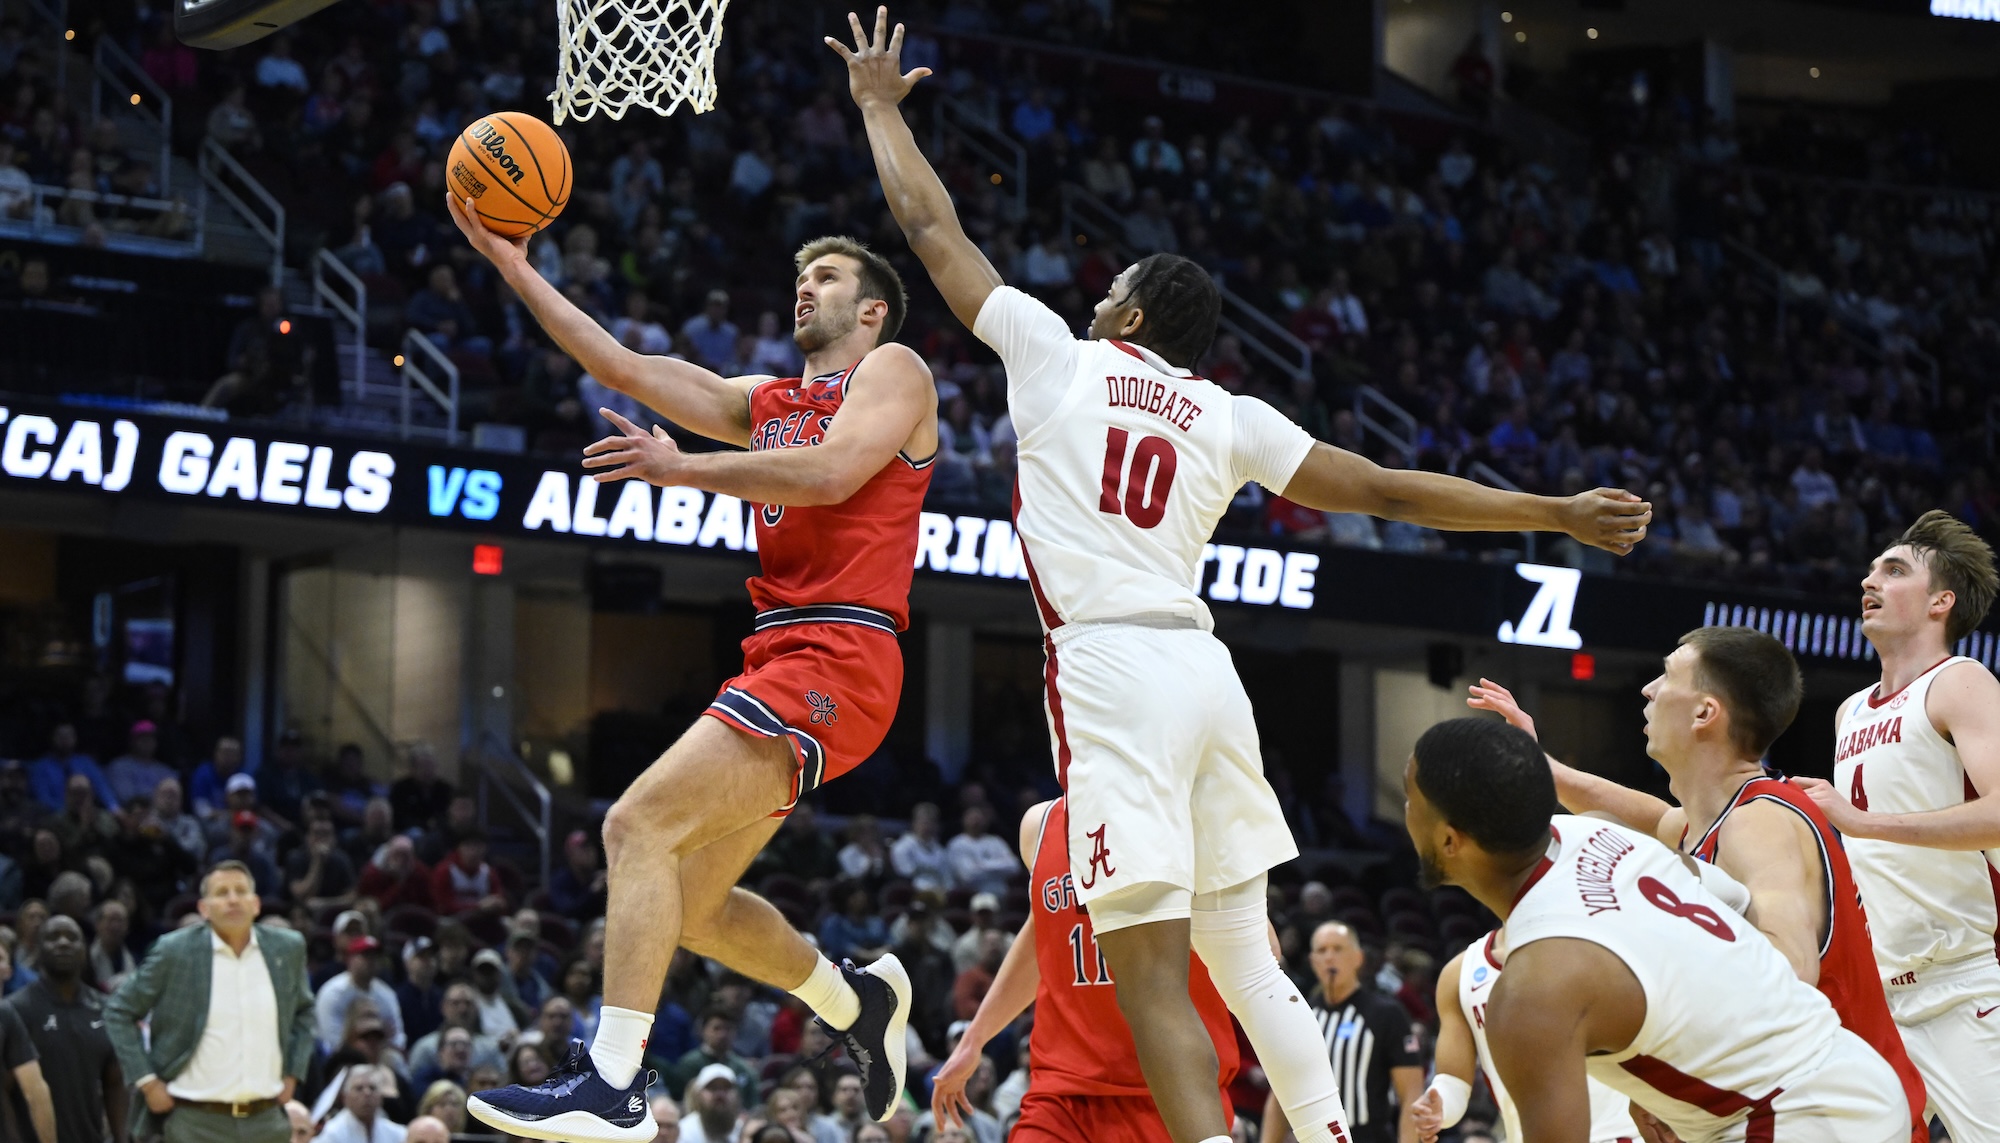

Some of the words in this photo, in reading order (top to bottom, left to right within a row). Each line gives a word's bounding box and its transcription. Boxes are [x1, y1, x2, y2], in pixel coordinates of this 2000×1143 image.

[458, 166, 477, 185] MARCH
[469, 120, 525, 185] Wilson
[457, 173, 481, 198] MADNESS
[1106, 376, 1203, 433] DIOUBATE
[0, 406, 140, 492] CA)
[158, 431, 396, 514] GAELS
[427, 464, 502, 521] VS
[523, 470, 758, 552] ALABA
[1099, 426, 1177, 529] 10
[1836, 716, 1903, 764] ALABAMA
[1851, 762, 1869, 812] 4
[1081, 823, 1116, 890] A
[1576, 827, 1635, 917] YOUNGBLOOD
[1637, 876, 1736, 942] 8
[1069, 922, 1115, 986] 11
